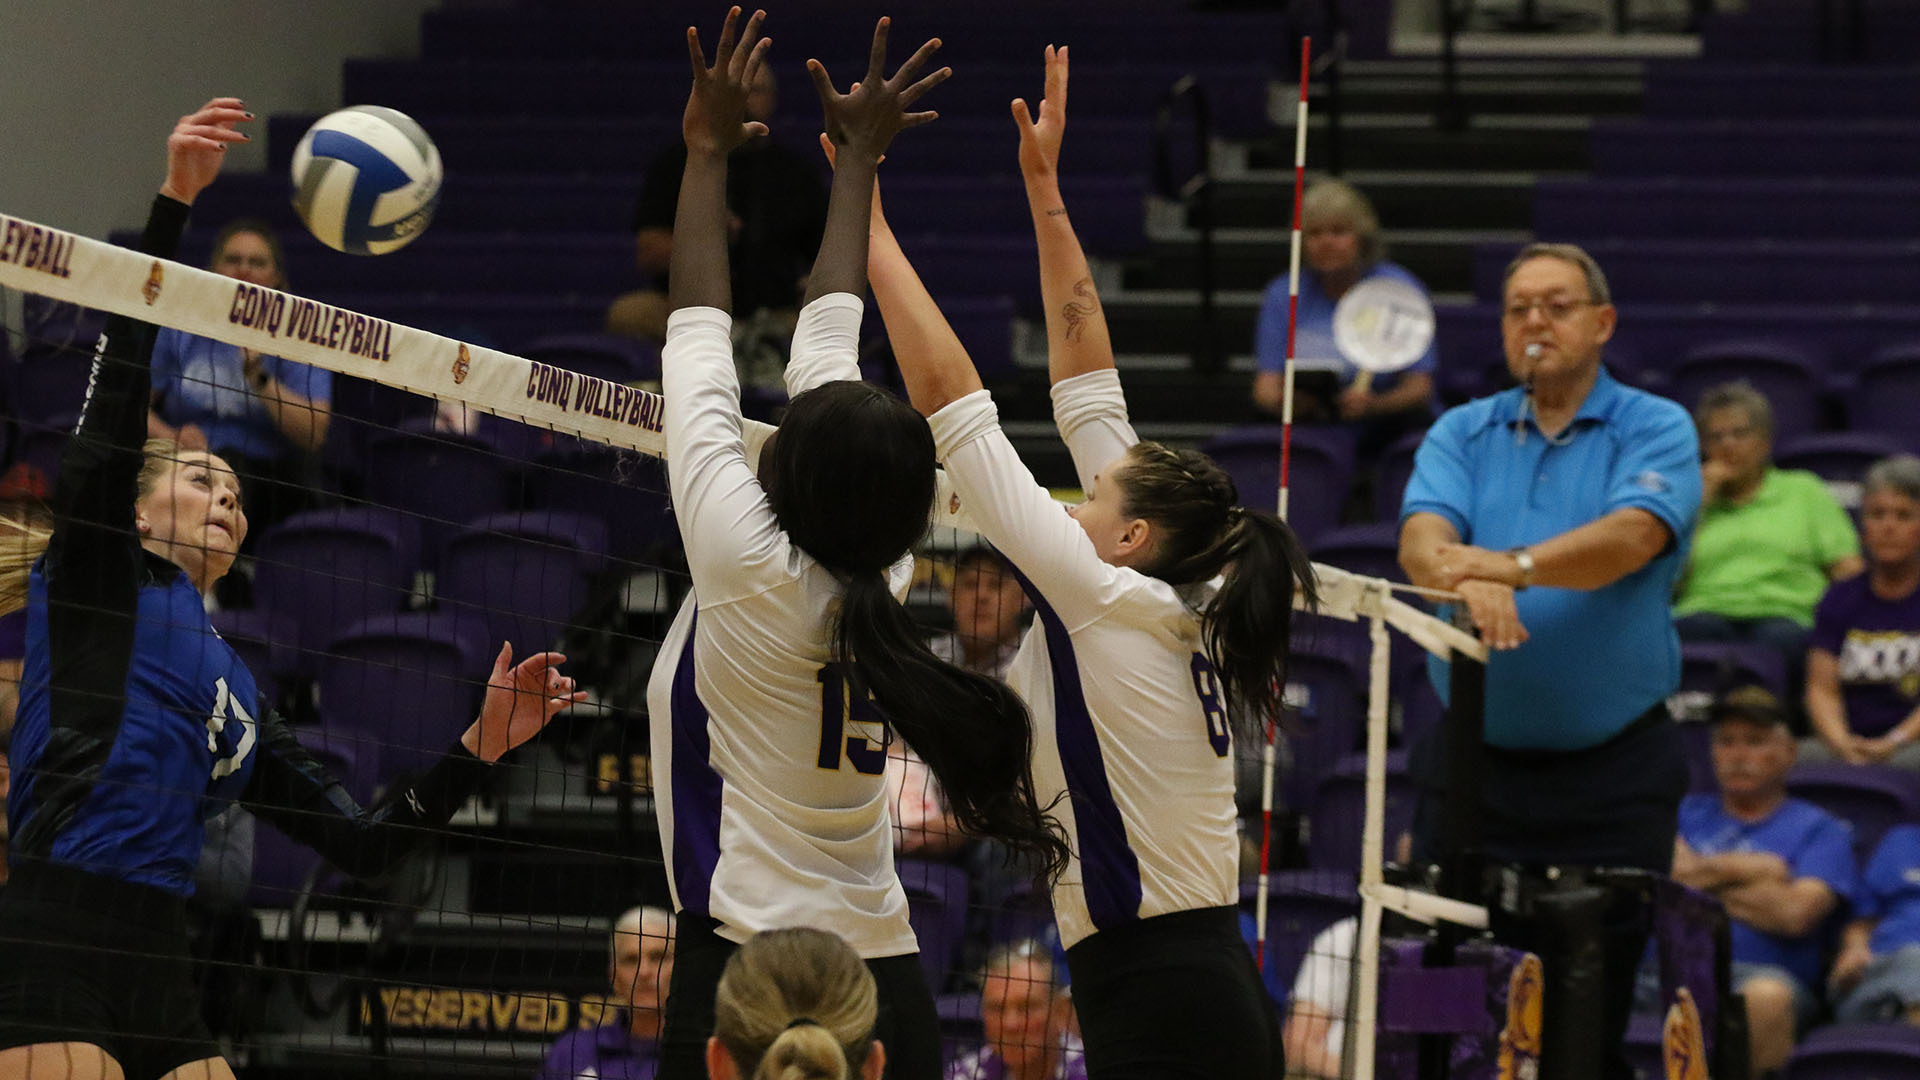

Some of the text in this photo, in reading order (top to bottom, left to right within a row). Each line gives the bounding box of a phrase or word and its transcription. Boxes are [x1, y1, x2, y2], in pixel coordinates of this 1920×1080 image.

[0, 216, 75, 278] EYBALL
[228, 283, 392, 362] CONQ VOLLEYBALL
[526, 361, 665, 433] CONQ VOLLEYBALL
[816, 661, 888, 776] 15
[1190, 651, 1230, 758] 8
